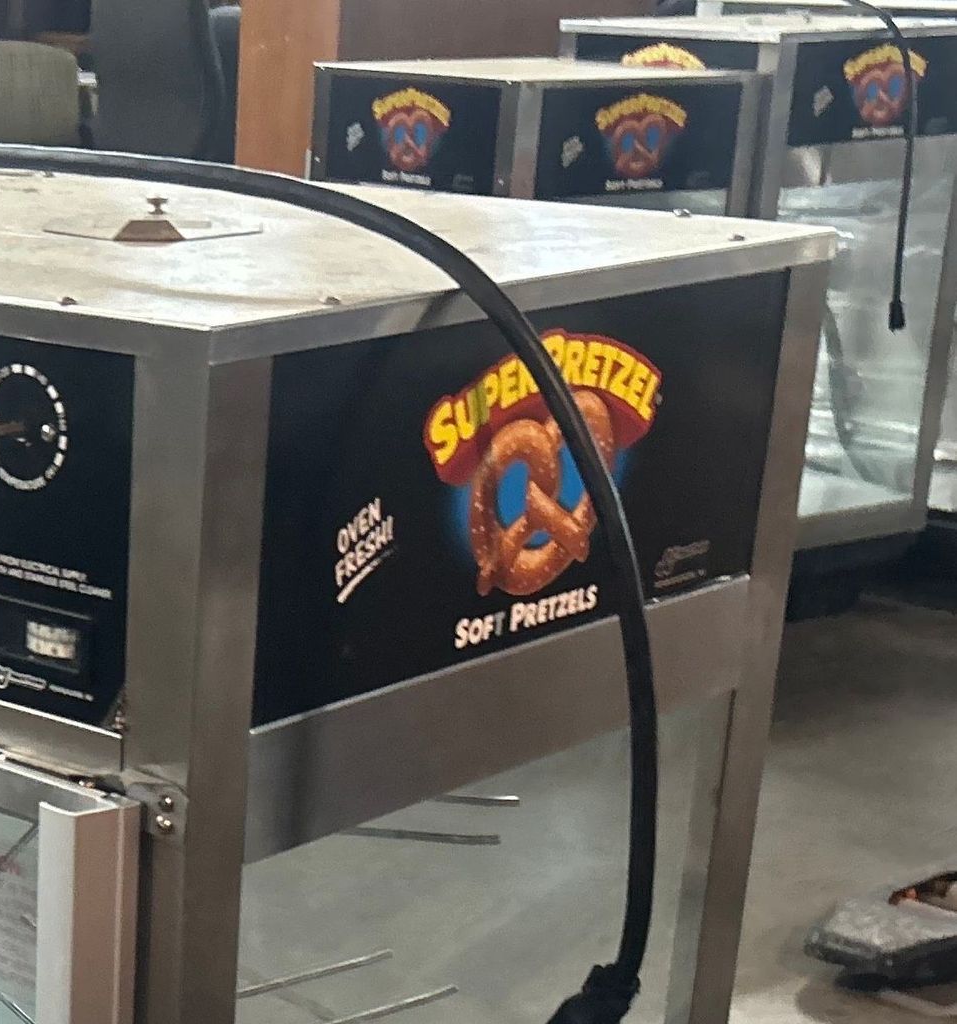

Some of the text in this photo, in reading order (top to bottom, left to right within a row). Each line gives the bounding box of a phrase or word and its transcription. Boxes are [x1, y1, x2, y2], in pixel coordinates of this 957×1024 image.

[335, 515, 393, 587] FRESH!
[337, 498, 381, 554] OVEN
[454, 584, 598, 649] SOFT PRETZELS
